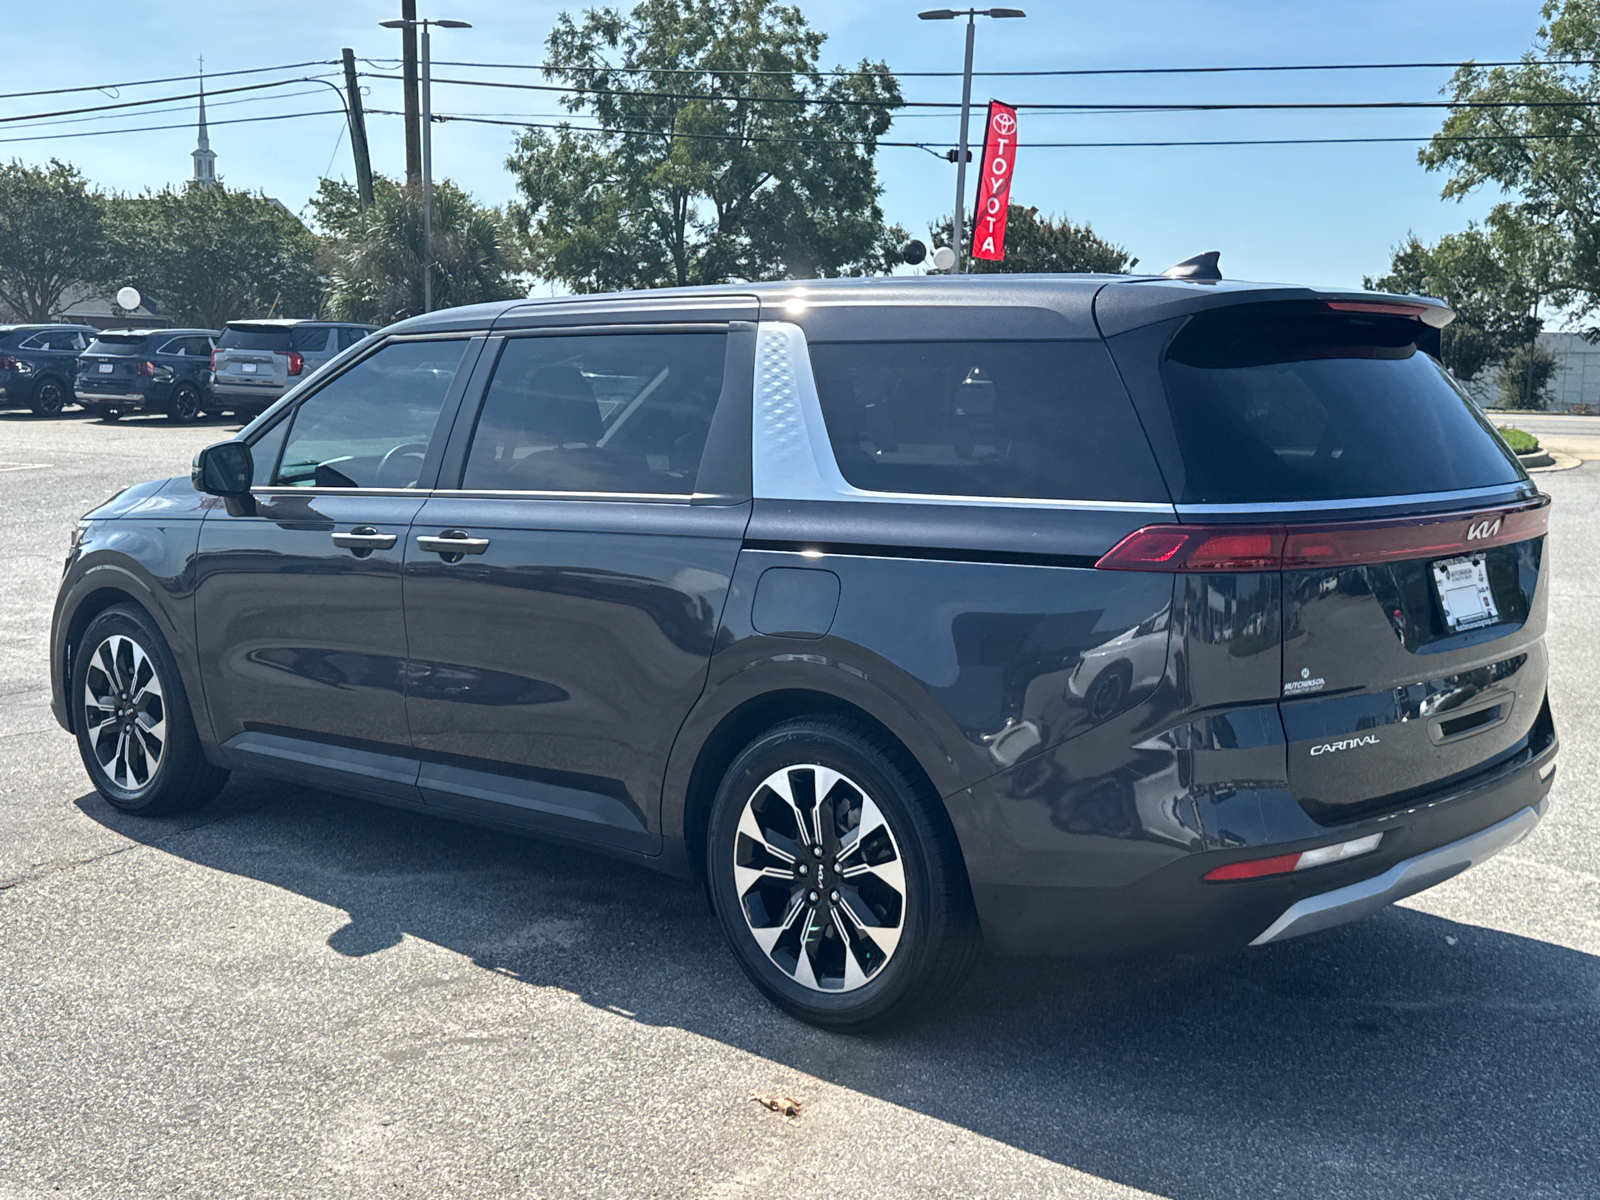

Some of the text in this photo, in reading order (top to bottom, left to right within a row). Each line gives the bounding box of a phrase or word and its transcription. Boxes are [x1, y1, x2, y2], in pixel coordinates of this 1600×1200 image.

[981, 138, 1009, 253] TOYOTA
[1467, 519, 1500, 540] KIA
[1284, 677, 1325, 690] HUTCHINSON
[1310, 734, 1380, 756] CARNIVAL
